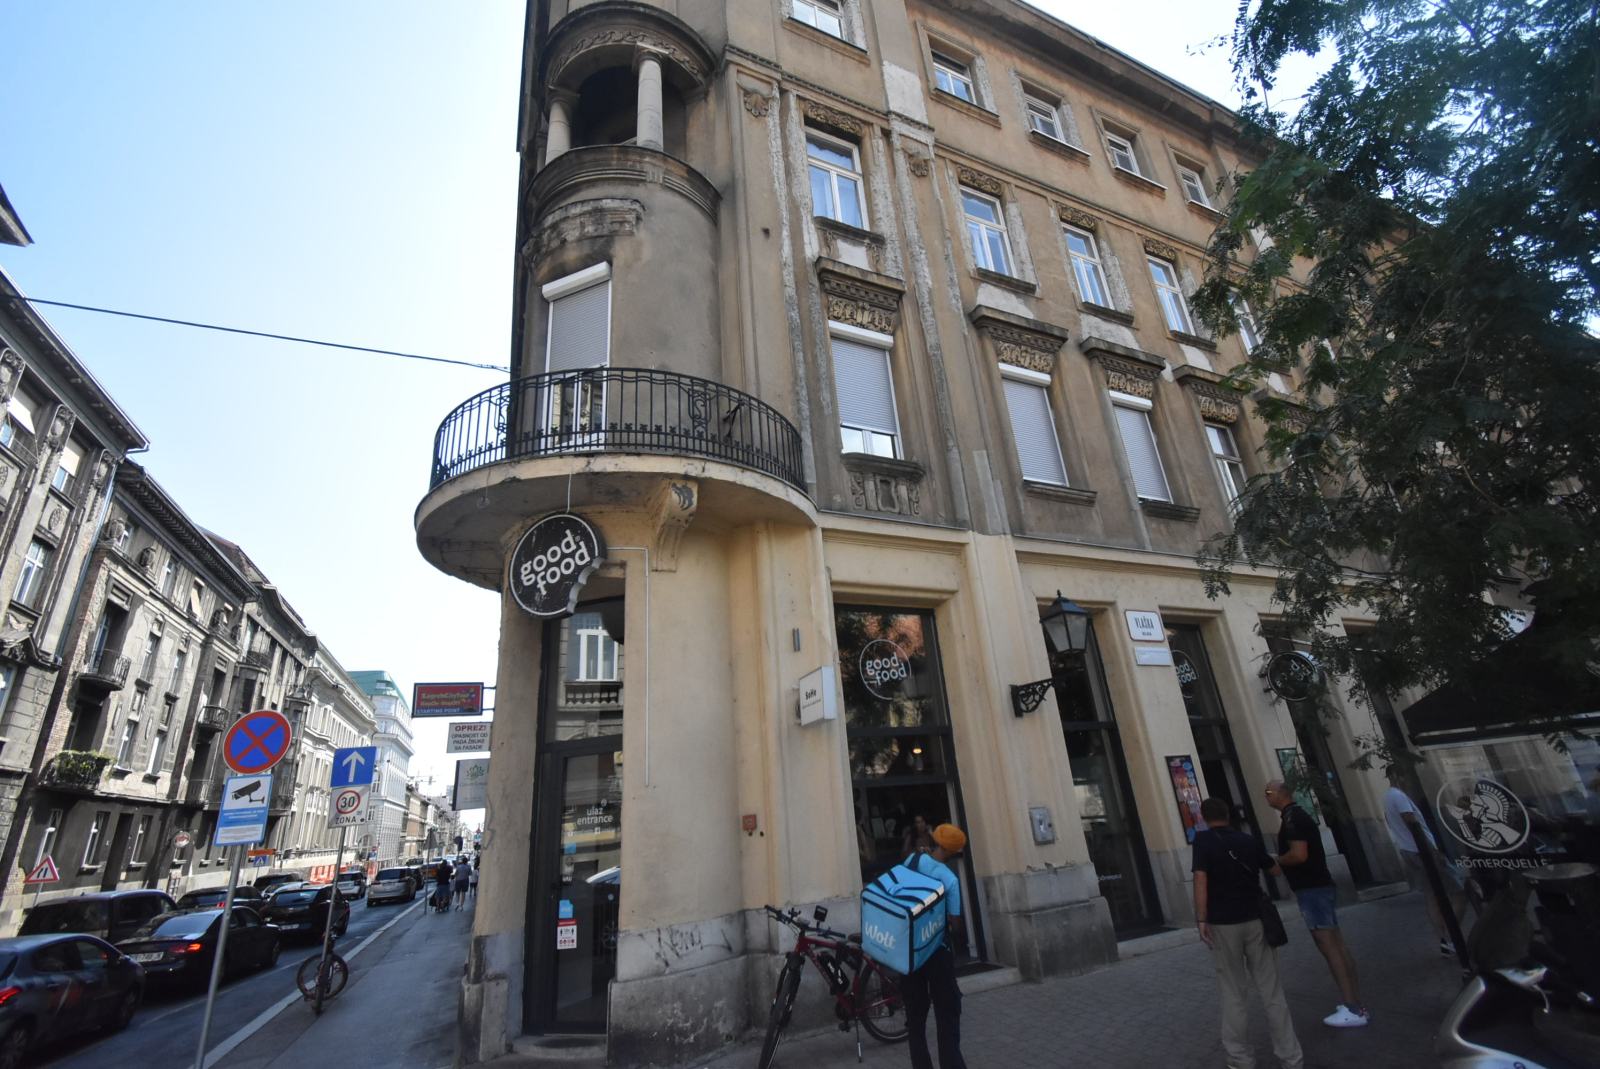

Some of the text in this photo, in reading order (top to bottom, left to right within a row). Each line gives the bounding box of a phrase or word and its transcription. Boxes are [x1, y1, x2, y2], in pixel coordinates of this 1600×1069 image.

[520, 529, 577, 586] good
[536, 541, 591, 596] food
[866, 652, 899, 675] good
[1175, 660, 1190, 674] ood
[876, 662, 907, 685] food
[340, 796, 356, 809] 30
[586, 806, 604, 816] ulaz
[335, 816, 357, 825] ZONA
[576, 815, 614, 826] entrance
[864, 922, 897, 950] Wolt
